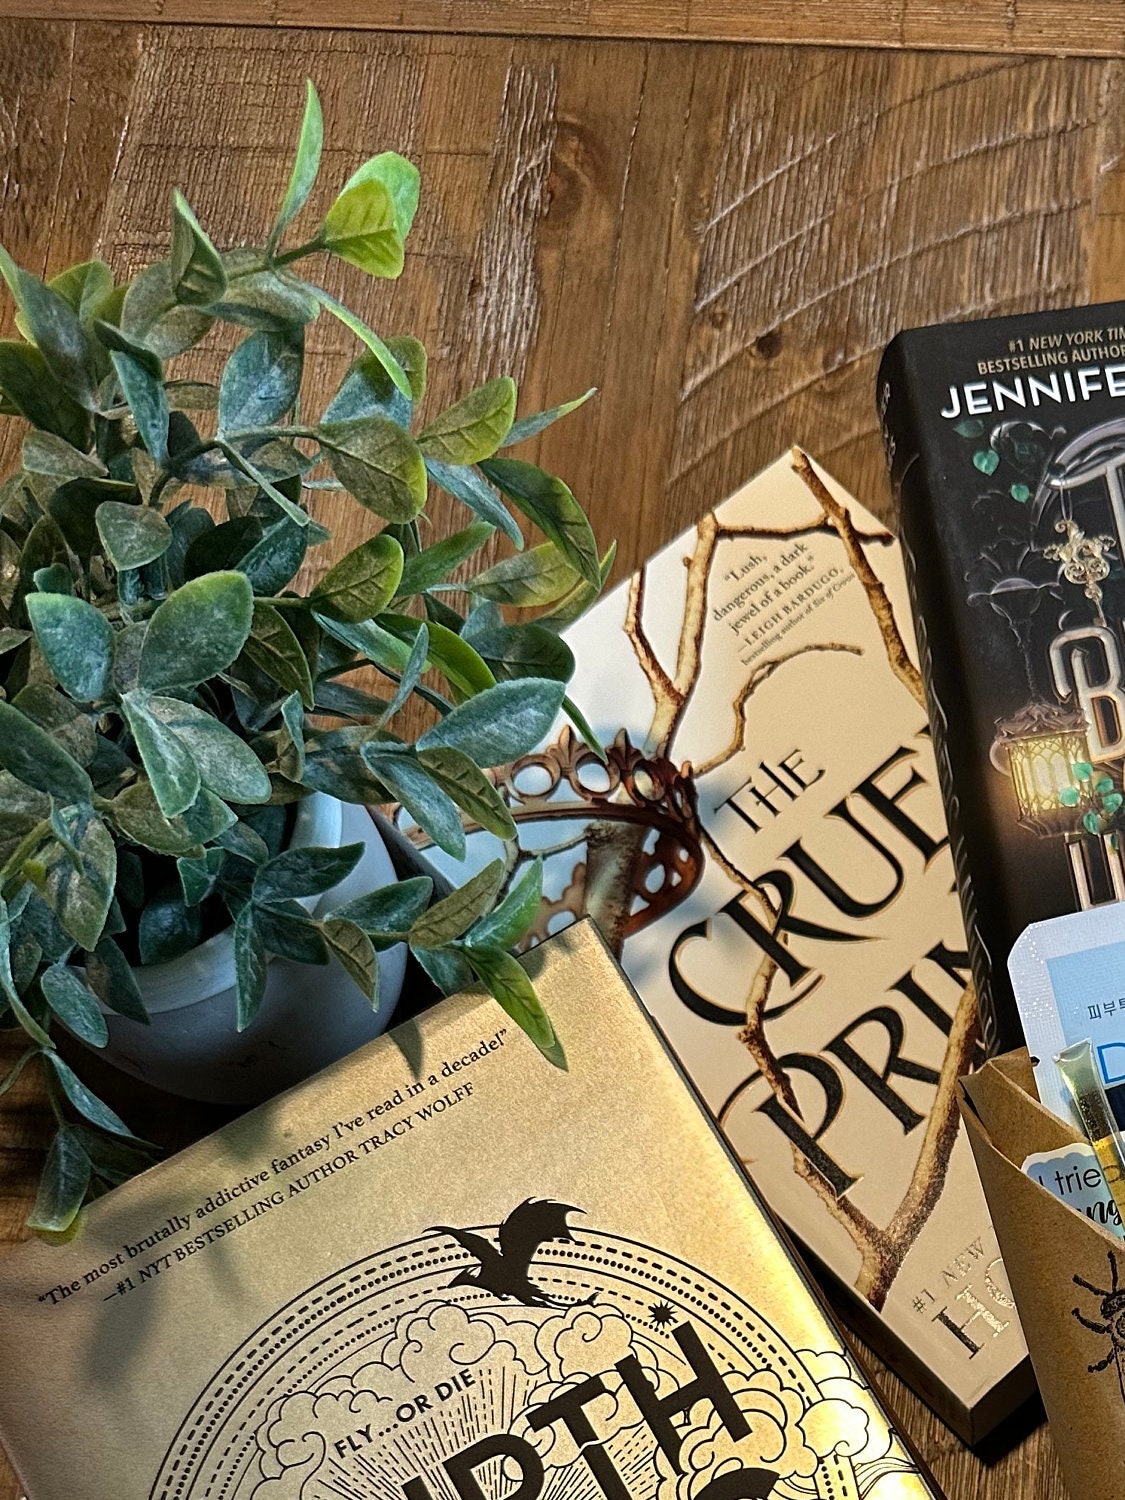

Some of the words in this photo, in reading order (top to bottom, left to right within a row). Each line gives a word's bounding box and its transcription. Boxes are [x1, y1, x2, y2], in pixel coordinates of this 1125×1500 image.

[977, 351, 1068, 376] BESTSELLING
[1008, 339, 1024, 353] #1
[1029, 333, 1063, 351] NEW
[1066, 329, 1103, 346] YORK
[712, 571, 776, 623] dangerous,
[772, 565, 782, 575] a
[781, 541, 809, 567] dark
[728, 605, 762, 637] jewel
[761, 590, 774, 608] of
[773, 588, 784, 599] a
[741, 632, 784, 667] bestselling
[713, 747, 828, 835] THE
[668, 724, 959, 1027] CRUE
[37, 1279, 82, 1306] “The
[83, 1252, 126, 1286] most
[123, 1212, 192, 1260] brutally
[195, 1167, 271, 1220] addictive
[270, 1134, 332, 1176] fantasy
[331, 1115, 366, 1140] I’ve
[366, 1089, 406, 1121] read
[405, 1080, 426, 1099] in
[427, 1074, 440, 1086] a
[441, 1028, 508, 1078] decade!”
[138, 1253, 173, 1285] NYT
[173, 1189, 286, 1264] BESTSELLING
[287, 1148, 361, 1199] AUTHOR
[357, 1115, 416, 1155] TRACY
[414, 1081, 476, 1122] WOLFF
[940, 1235, 985, 1290] NEW
[931, 1256, 1017, 1360] HO
[433, 1367, 479, 1406] DIE
